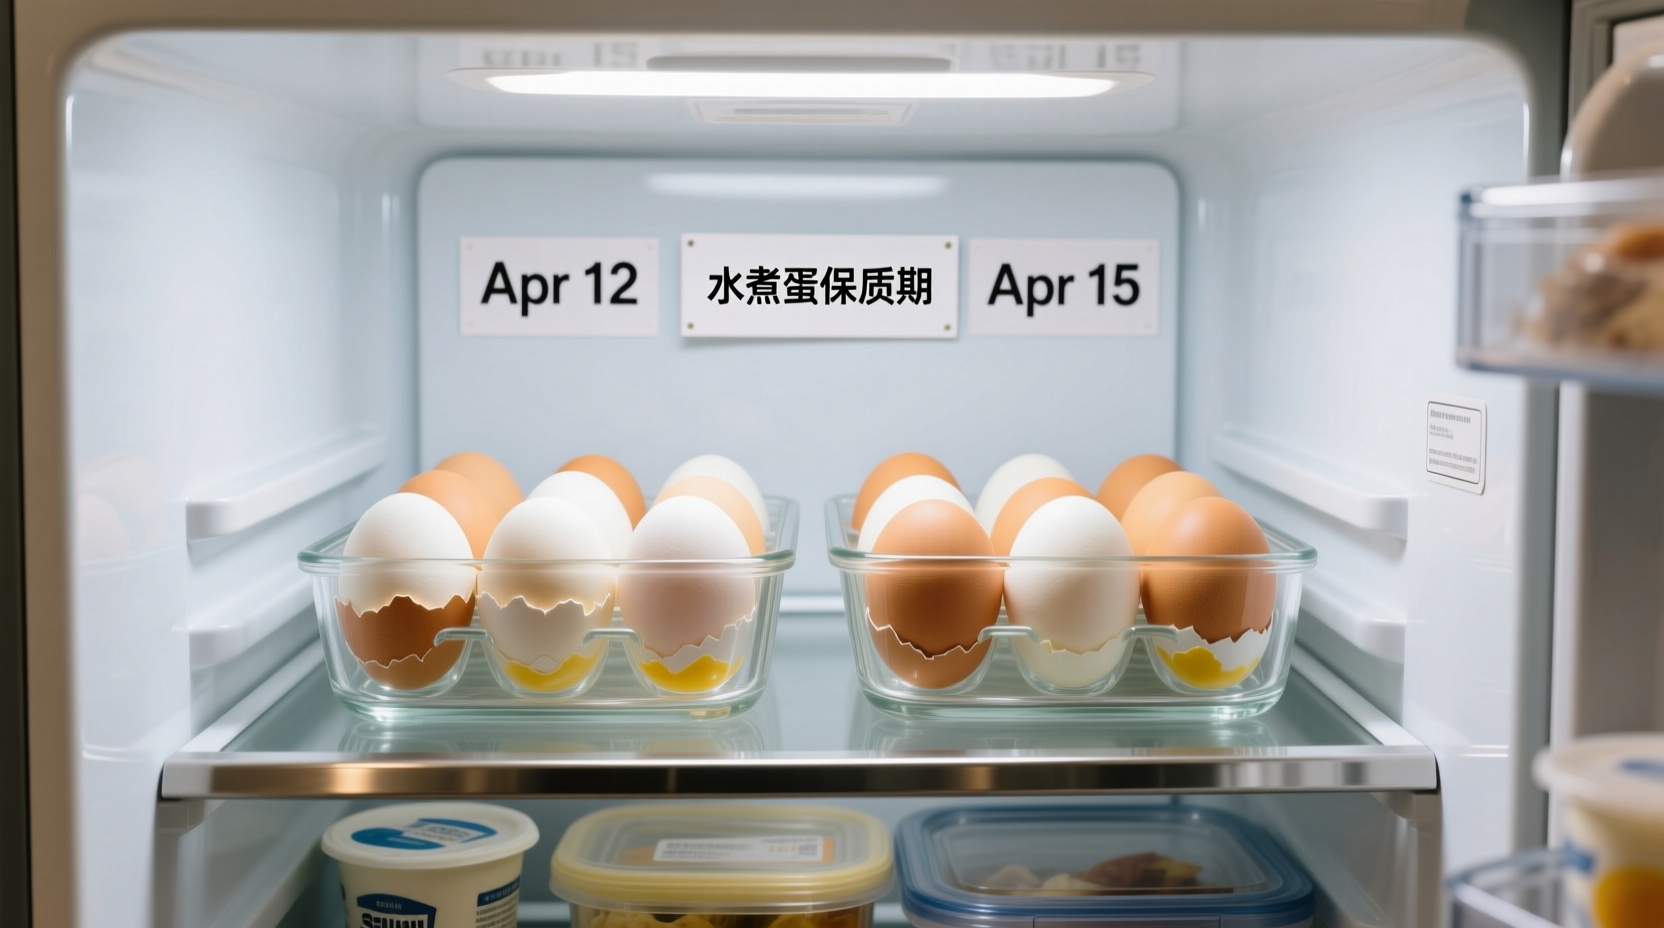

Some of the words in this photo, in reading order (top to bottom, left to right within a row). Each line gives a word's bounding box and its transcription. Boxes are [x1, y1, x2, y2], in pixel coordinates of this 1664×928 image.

[480, 261, 570, 318] Apr
[584, 261, 638, 305] 12
[707, 265, 932, 306] 水煮蛋保质期
[987, 262, 1075, 318] Apr
[1088, 263, 1141, 307] 15
